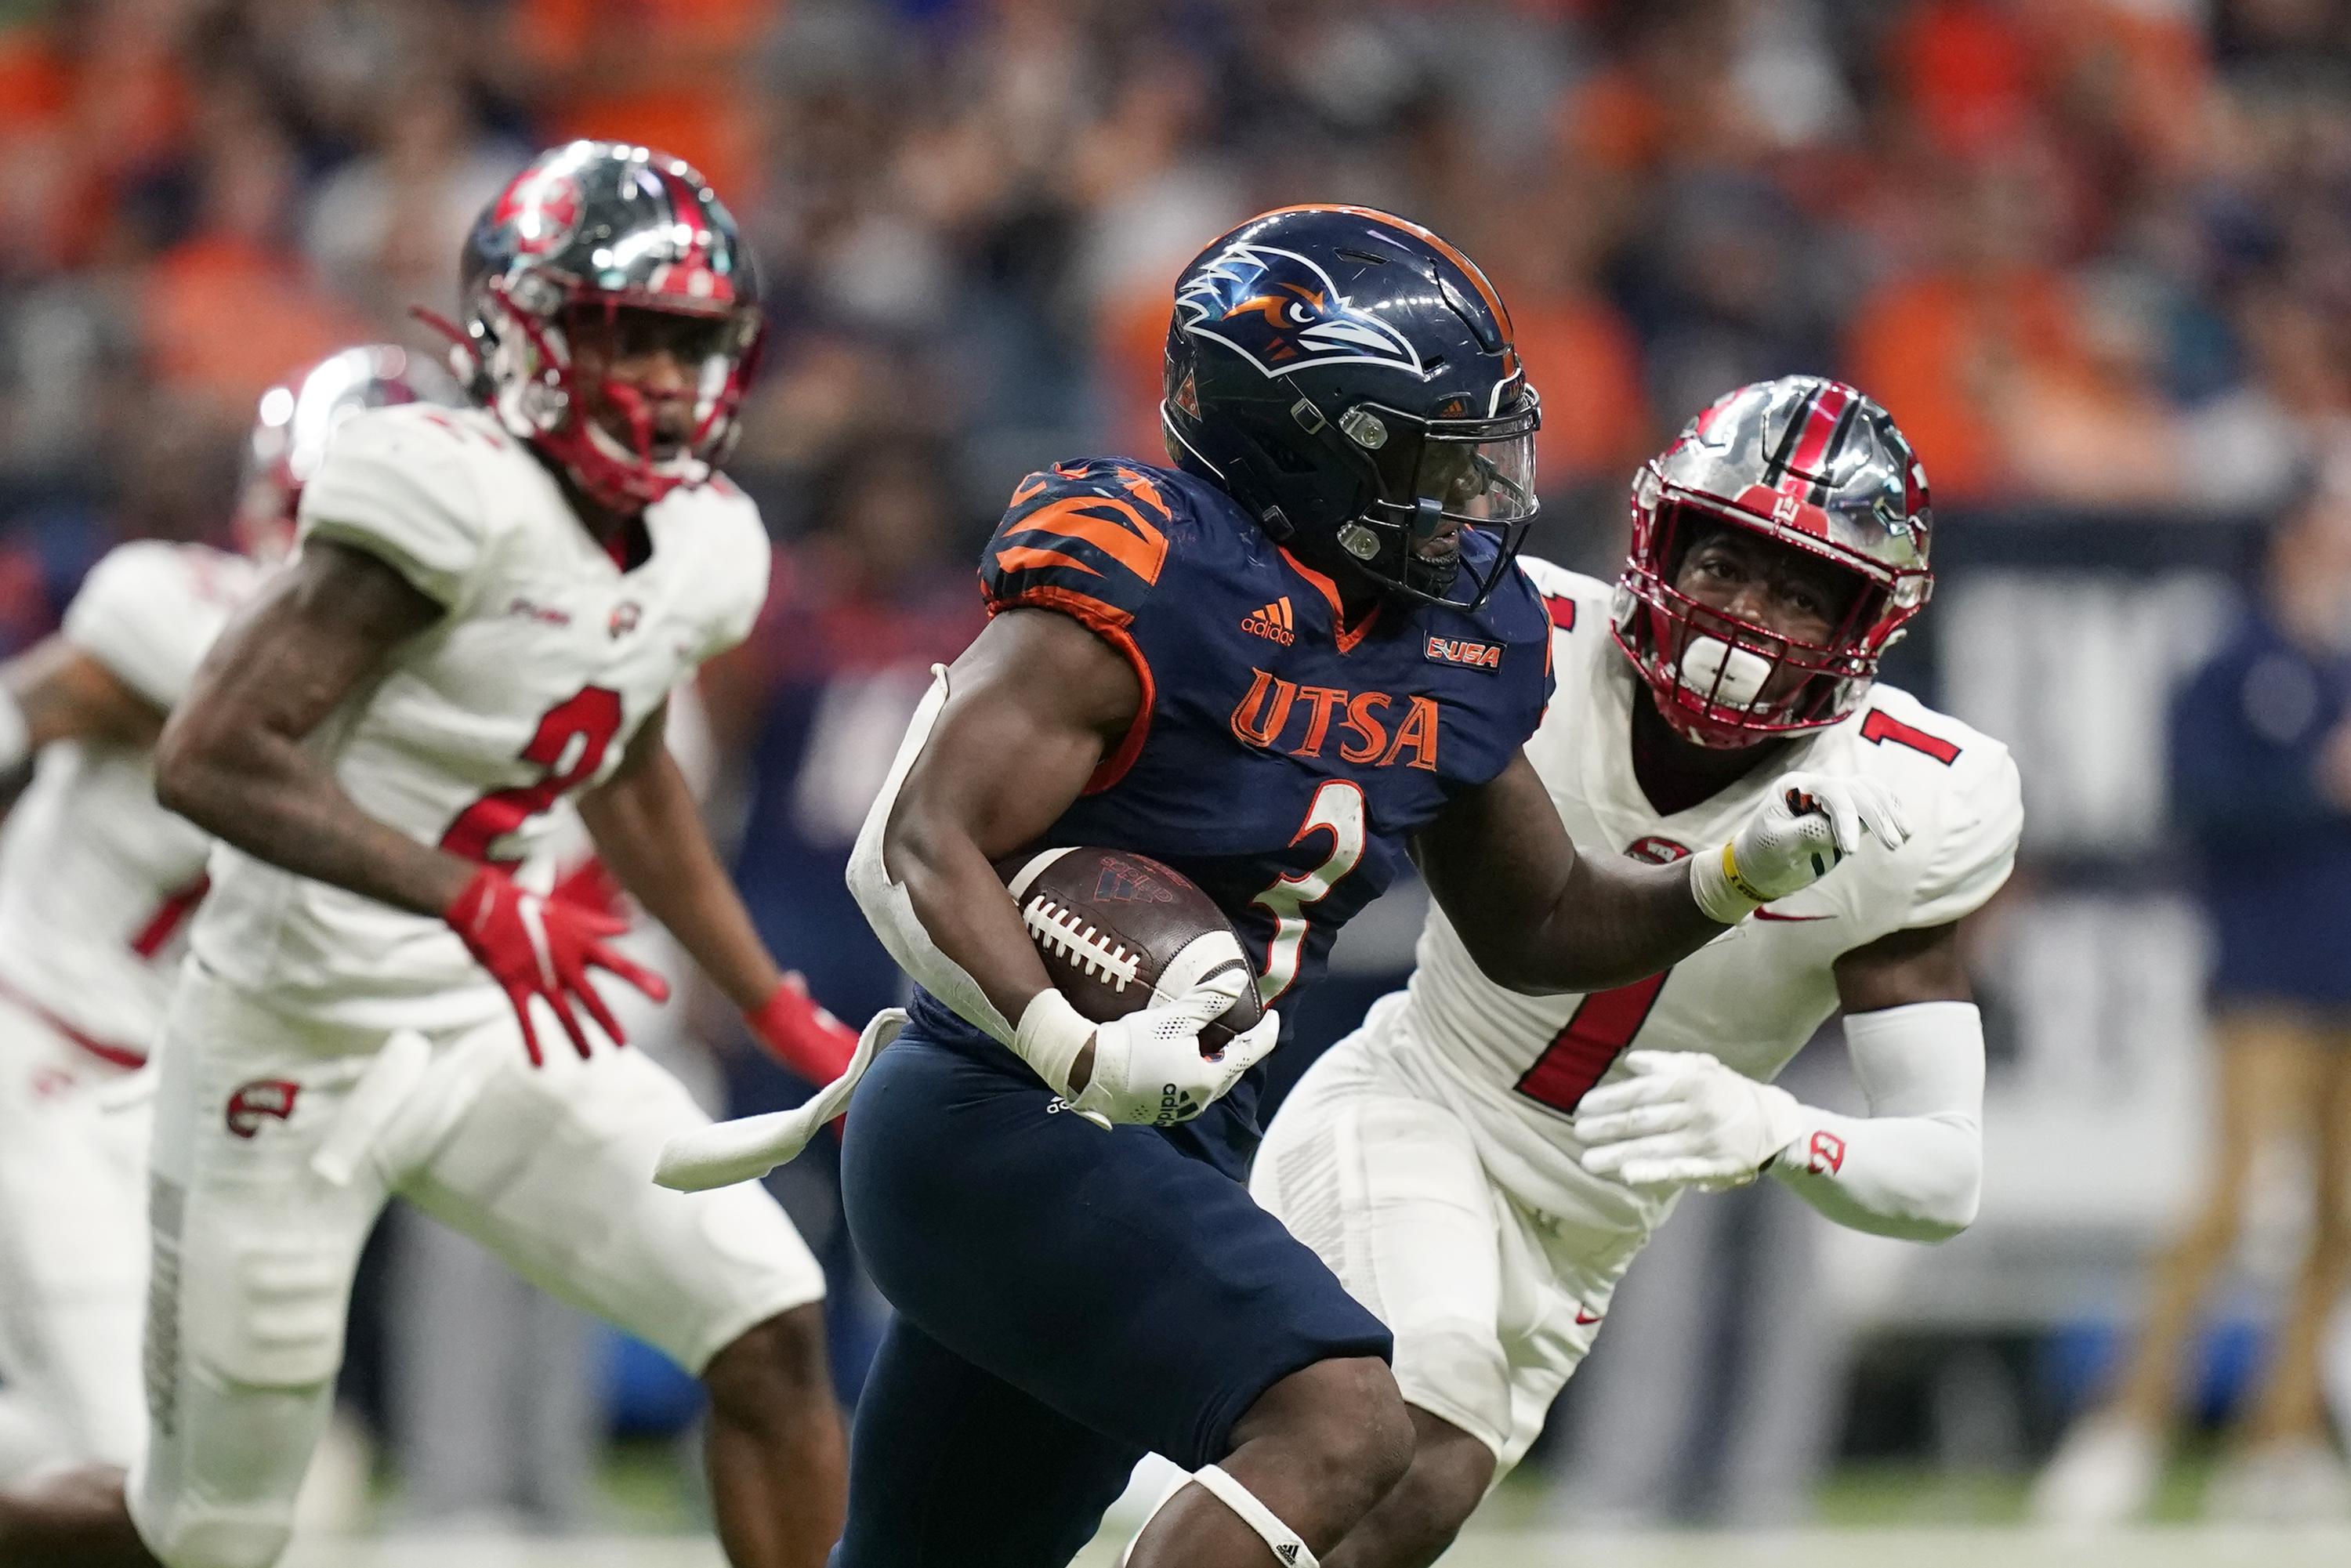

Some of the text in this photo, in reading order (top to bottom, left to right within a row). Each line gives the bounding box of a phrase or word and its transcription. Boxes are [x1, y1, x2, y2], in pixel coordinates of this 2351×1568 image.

[1241, 617, 1295, 646] adidas
[1230, 666, 1440, 773] UTSA
[1859, 706, 1963, 767] 1
[437, 683, 624, 878] 2
[1244, 778, 1365, 1011] 3
[1153, 1083, 1178, 1127] adida
